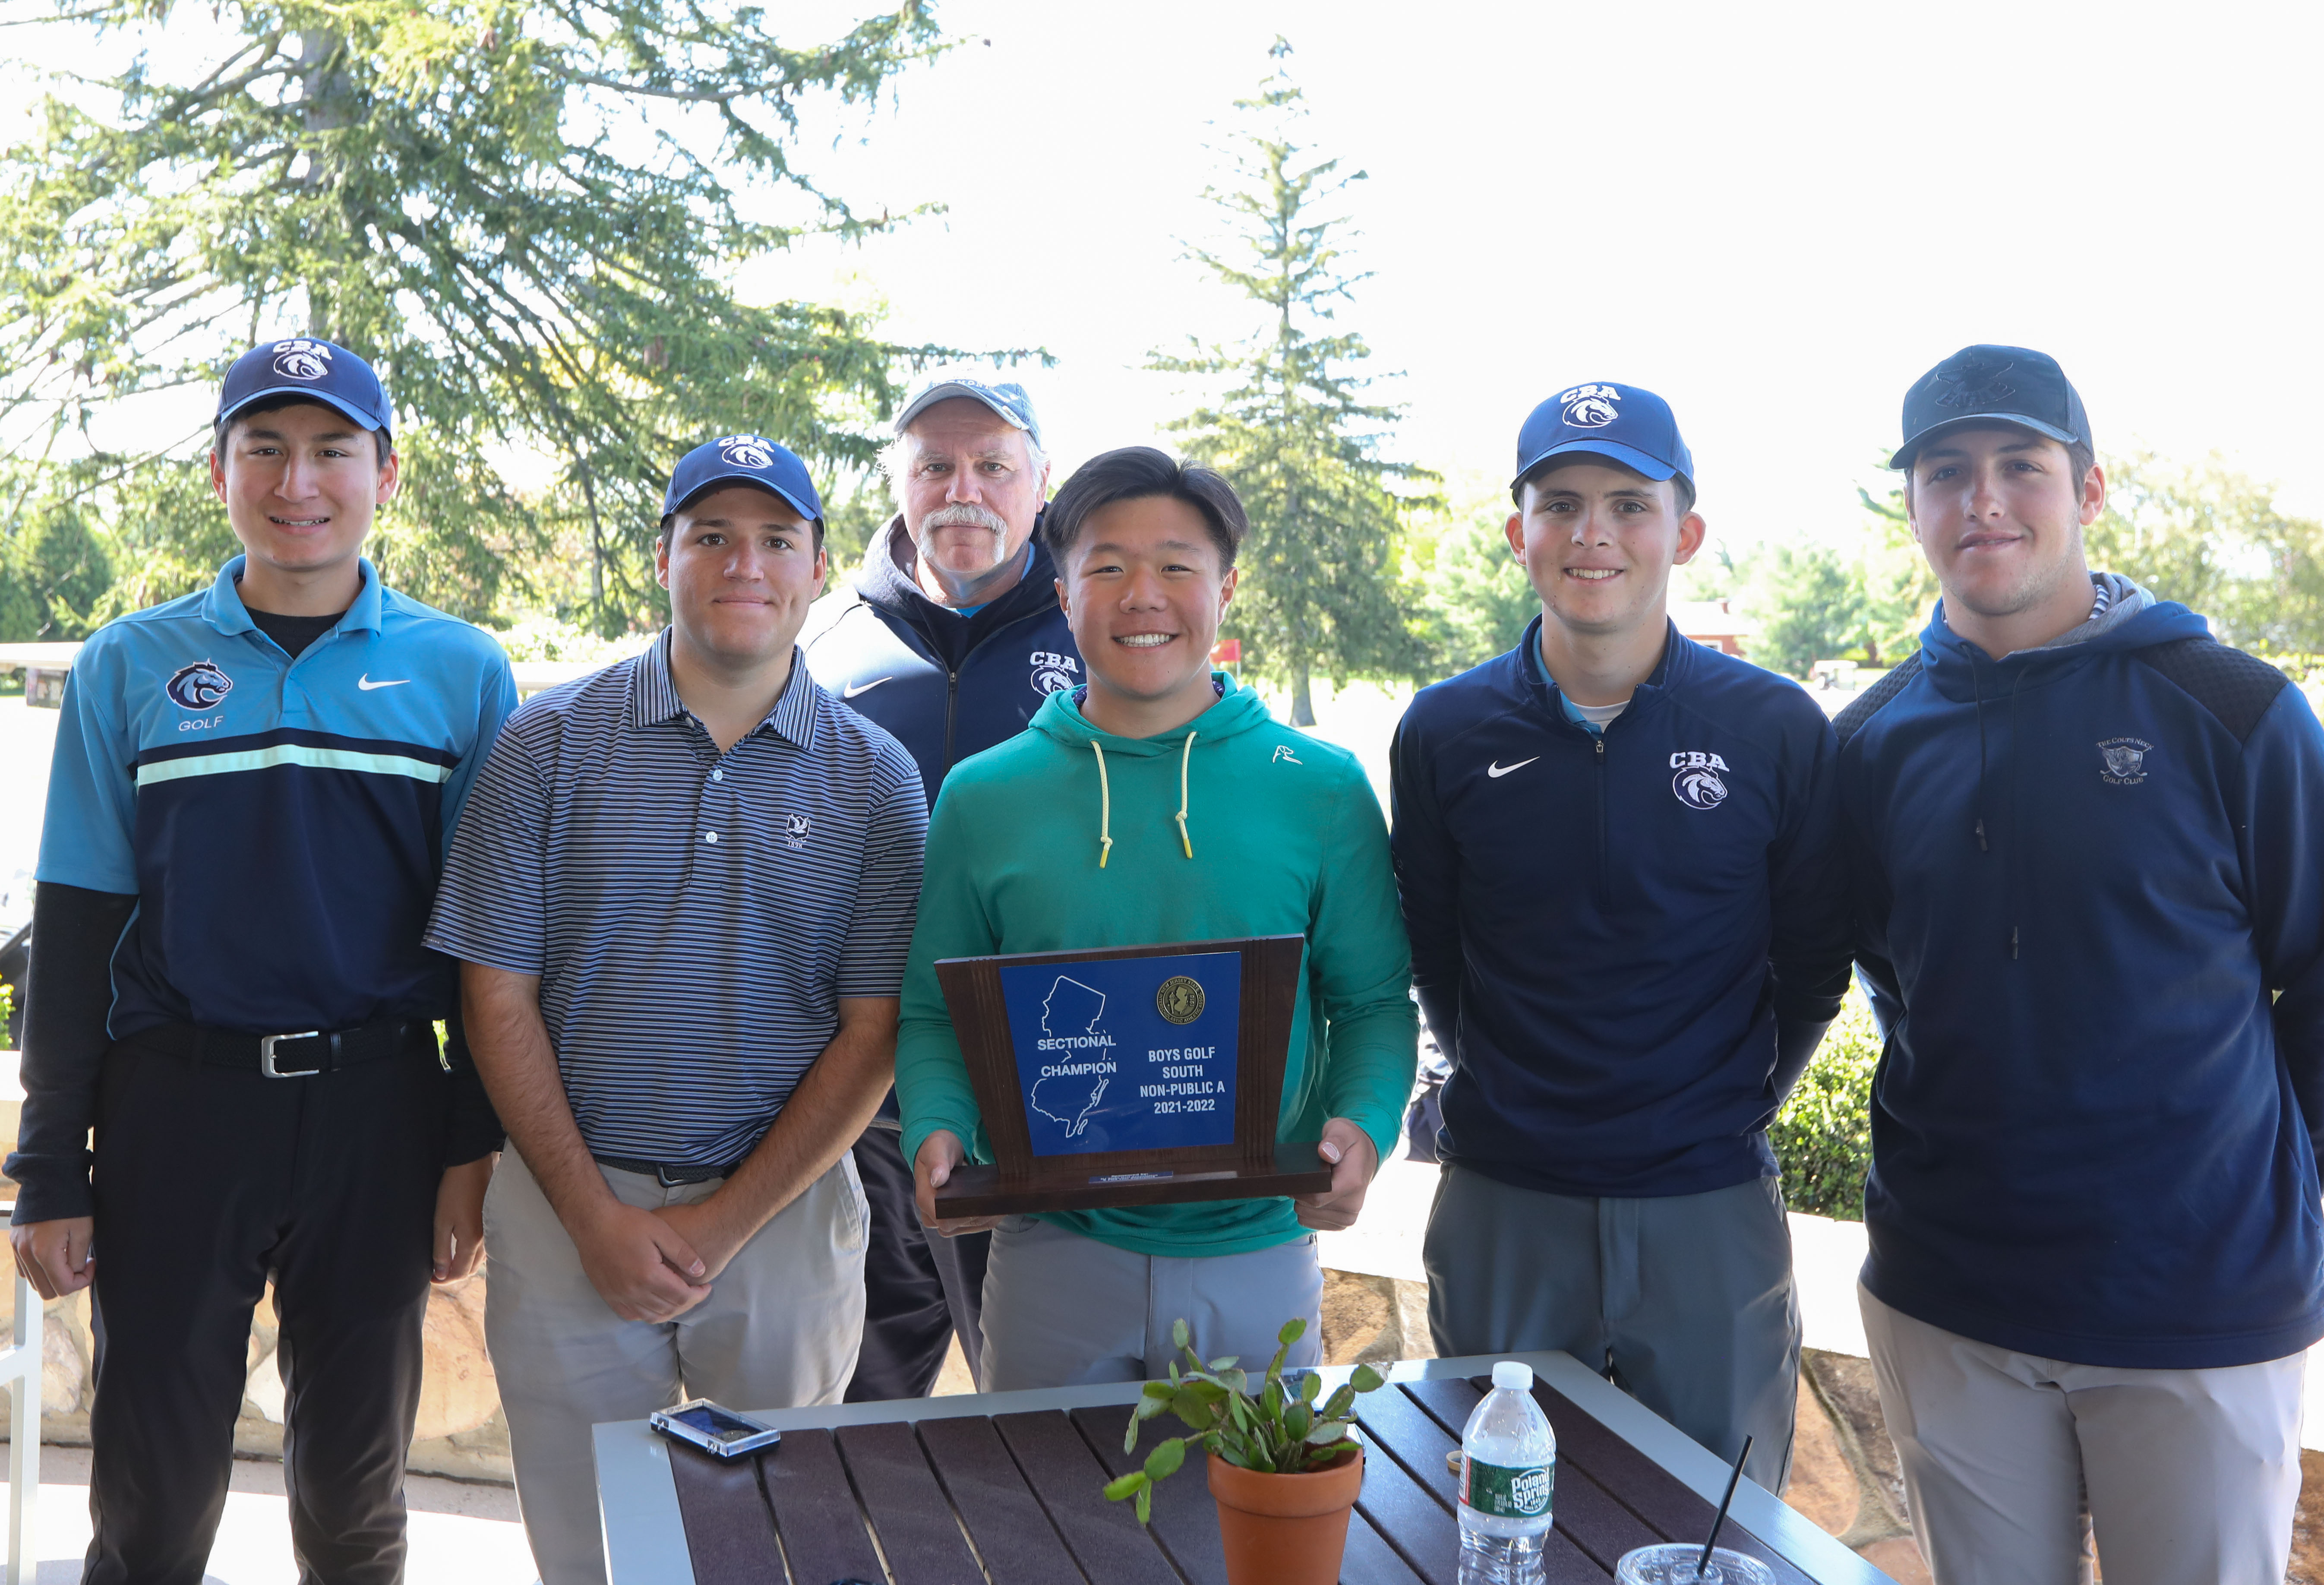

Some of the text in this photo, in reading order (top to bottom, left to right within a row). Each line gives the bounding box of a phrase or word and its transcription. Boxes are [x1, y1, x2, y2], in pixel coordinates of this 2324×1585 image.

[273, 340, 332, 361] CBA
[1560, 385, 1622, 404] CBA
[718, 435, 774, 453] CBA
[1029, 651, 1079, 674] CBA
[178, 715, 224, 731] GOLF
[2096, 740, 2111, 748] THE
[2135, 738, 2154, 750] NECK
[1669, 751, 1730, 772] CBA
[2103, 775, 2122, 784] GOLF
[1187, 981, 1200, 991] STATE
[1184, 1008, 1201, 1022] ATHLETIC
[1037, 1035, 1116, 1050] SECTIONAL
[1148, 1047, 1216, 1063] BOYS GOLF
[1041, 1062, 1116, 1078] CHAMPION
[1162, 1065, 1203, 1079] SOUTH
[1140, 1081, 1225, 1098] NON-PUBLIC A
[1154, 1099, 1216, 1114] 2021-2022
[1511, 1467, 1550, 1493] Poland
[1512, 1482, 1550, 1509] Spring
